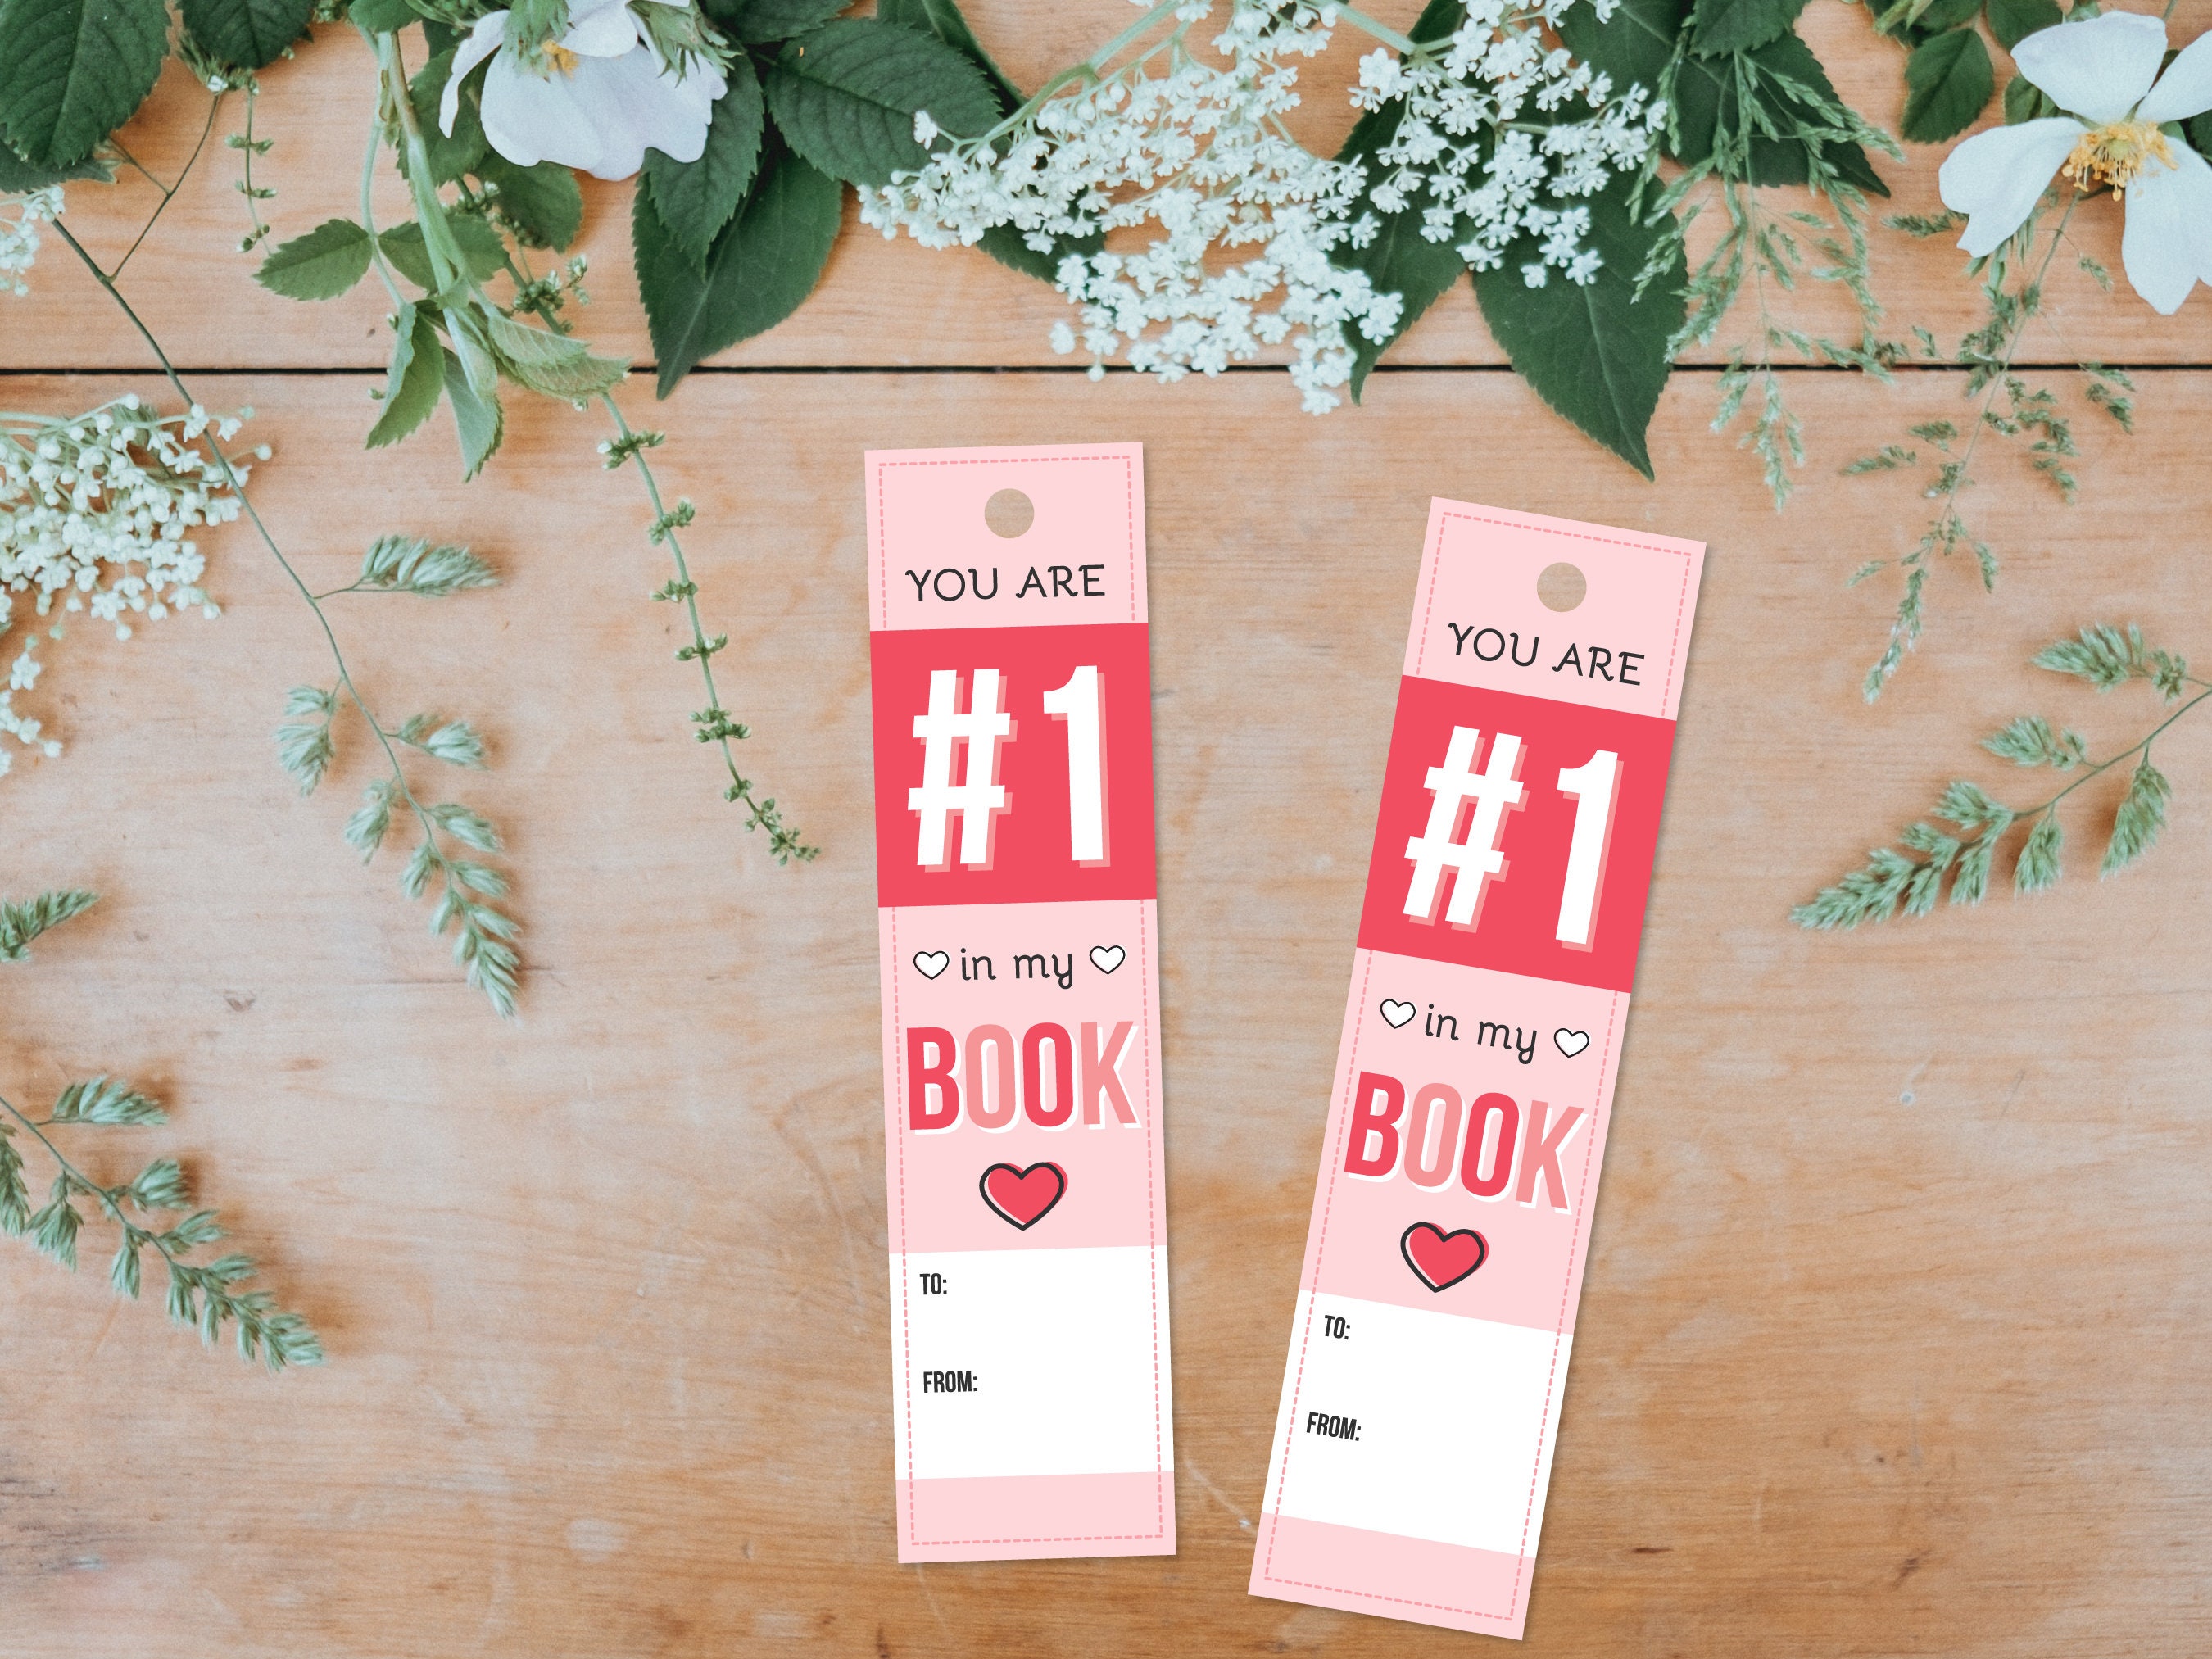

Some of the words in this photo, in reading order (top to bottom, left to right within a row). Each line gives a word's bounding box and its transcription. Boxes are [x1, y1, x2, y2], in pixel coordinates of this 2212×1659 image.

[905, 568, 997, 601] YOU
[1016, 564, 1104, 598] ARE
[1448, 623, 1539, 666] YOU
[1552, 643, 1644, 686] ARE
[908, 665, 1110, 873] #1
[1403, 726, 1624, 952] #1
[961, 948, 996, 980] in
[1013, 954, 1072, 989] my
[1426, 1004, 1458, 1040] in
[1478, 1022, 1537, 1064] my
[907, 1021, 1140, 1134] BOOK
[1344, 1071, 1588, 1213] BOOK
[920, 1273, 946, 1294] TO:
[1325, 1315, 1350, 1339] TO:
[924, 1371, 977, 1393] FROM:
[1307, 1412, 1361, 1441] FROM:
